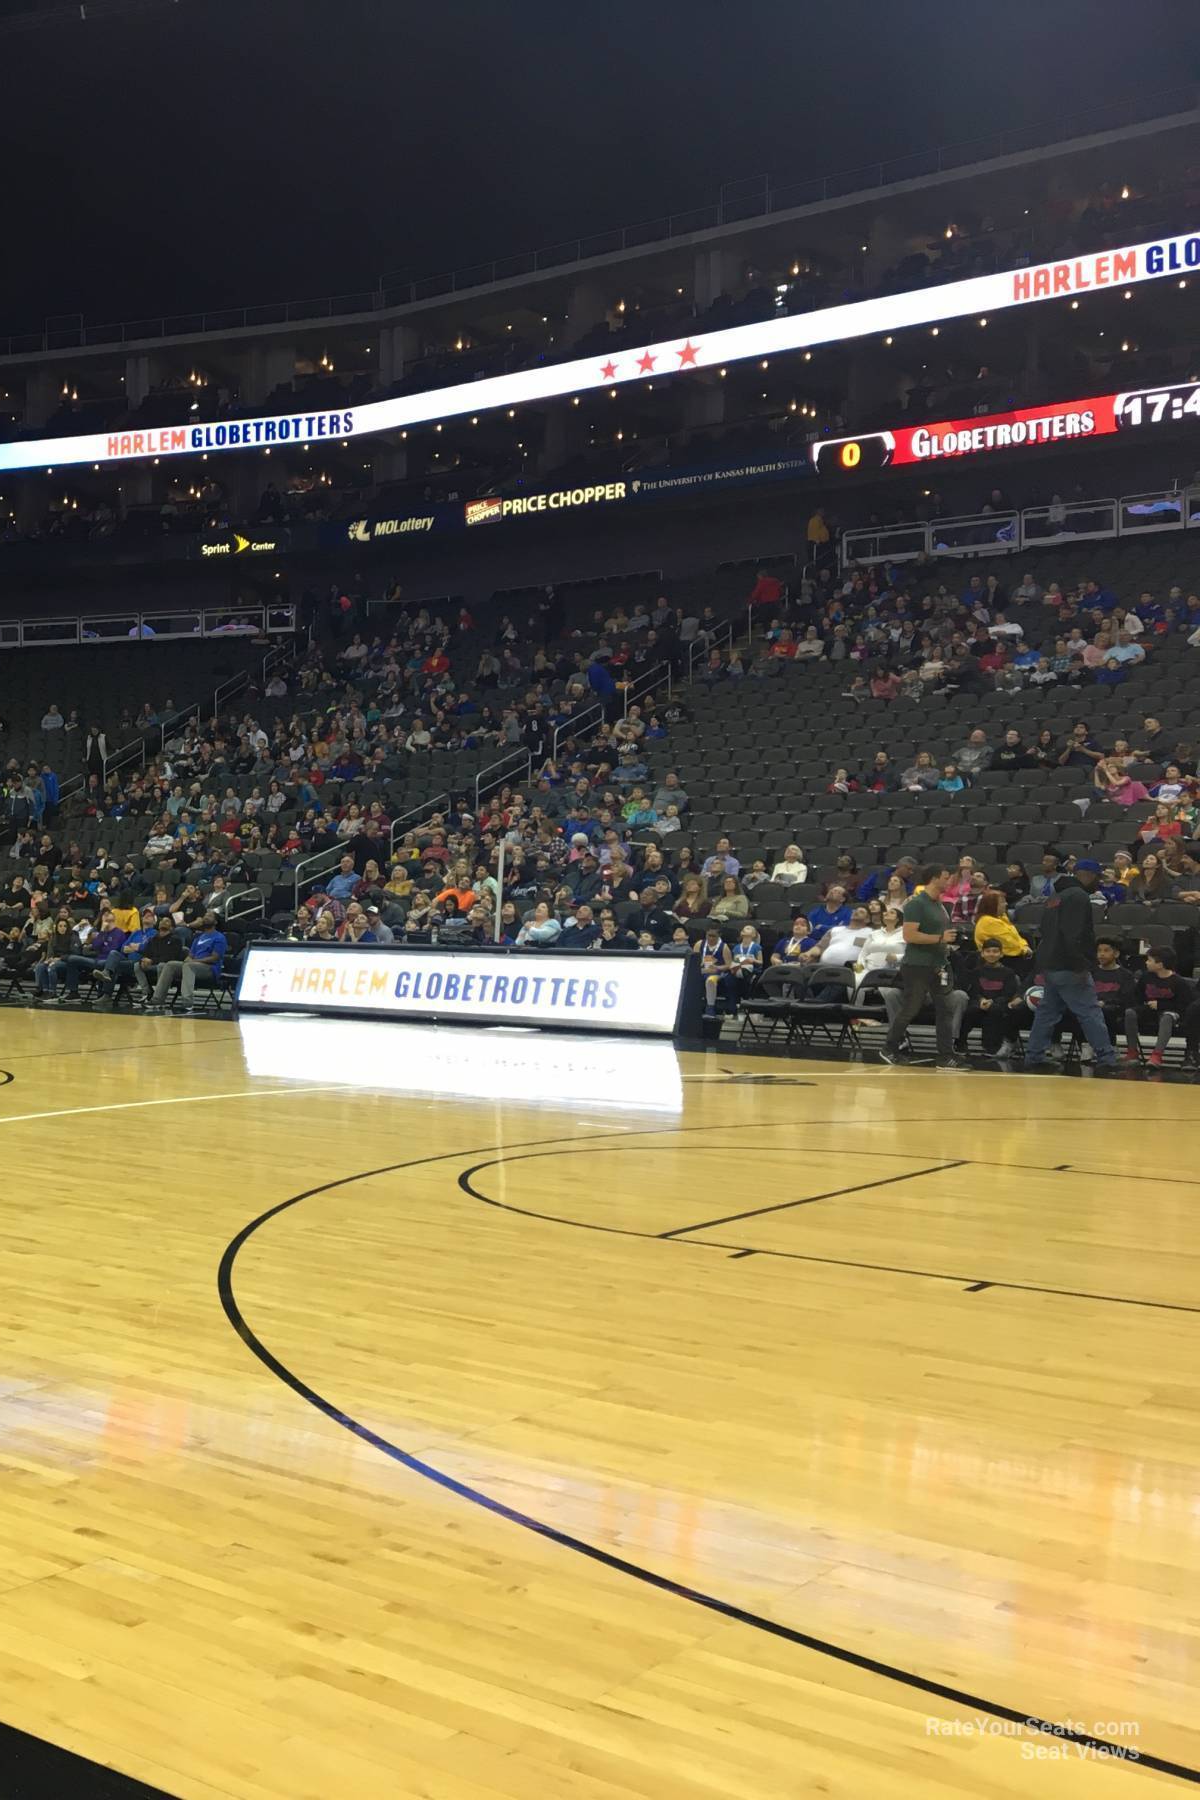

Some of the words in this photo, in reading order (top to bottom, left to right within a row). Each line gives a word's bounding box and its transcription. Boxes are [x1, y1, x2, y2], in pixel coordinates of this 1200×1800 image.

[1013, 250, 1137, 301] HARLEM
[107, 430, 186, 456] HARLEM
[191, 412, 354, 449] GLOBETROTTERS
[910, 410, 1095, 458] GLOBETROTTERS
[841, 442, 861, 468] 0
[642, 481, 657, 490] THE
[658, 474, 702, 488] UNIVERSITY
[714, 469, 744, 480] KANSAS
[745, 463, 775, 475] HEALTH
[467, 500, 488, 515] PRICE
[502, 494, 546, 516] PRICE
[549, 482, 626, 508] CHOPPER
[374, 517, 435, 536] MOLottery
[466, 506, 500, 524] CHOPPER
[201, 543, 230, 556] Sprint
[251, 541, 275, 551] Center
[290, 967, 389, 996] HARLEM
[394, 971, 619, 1009] GLOBETROTTERS
